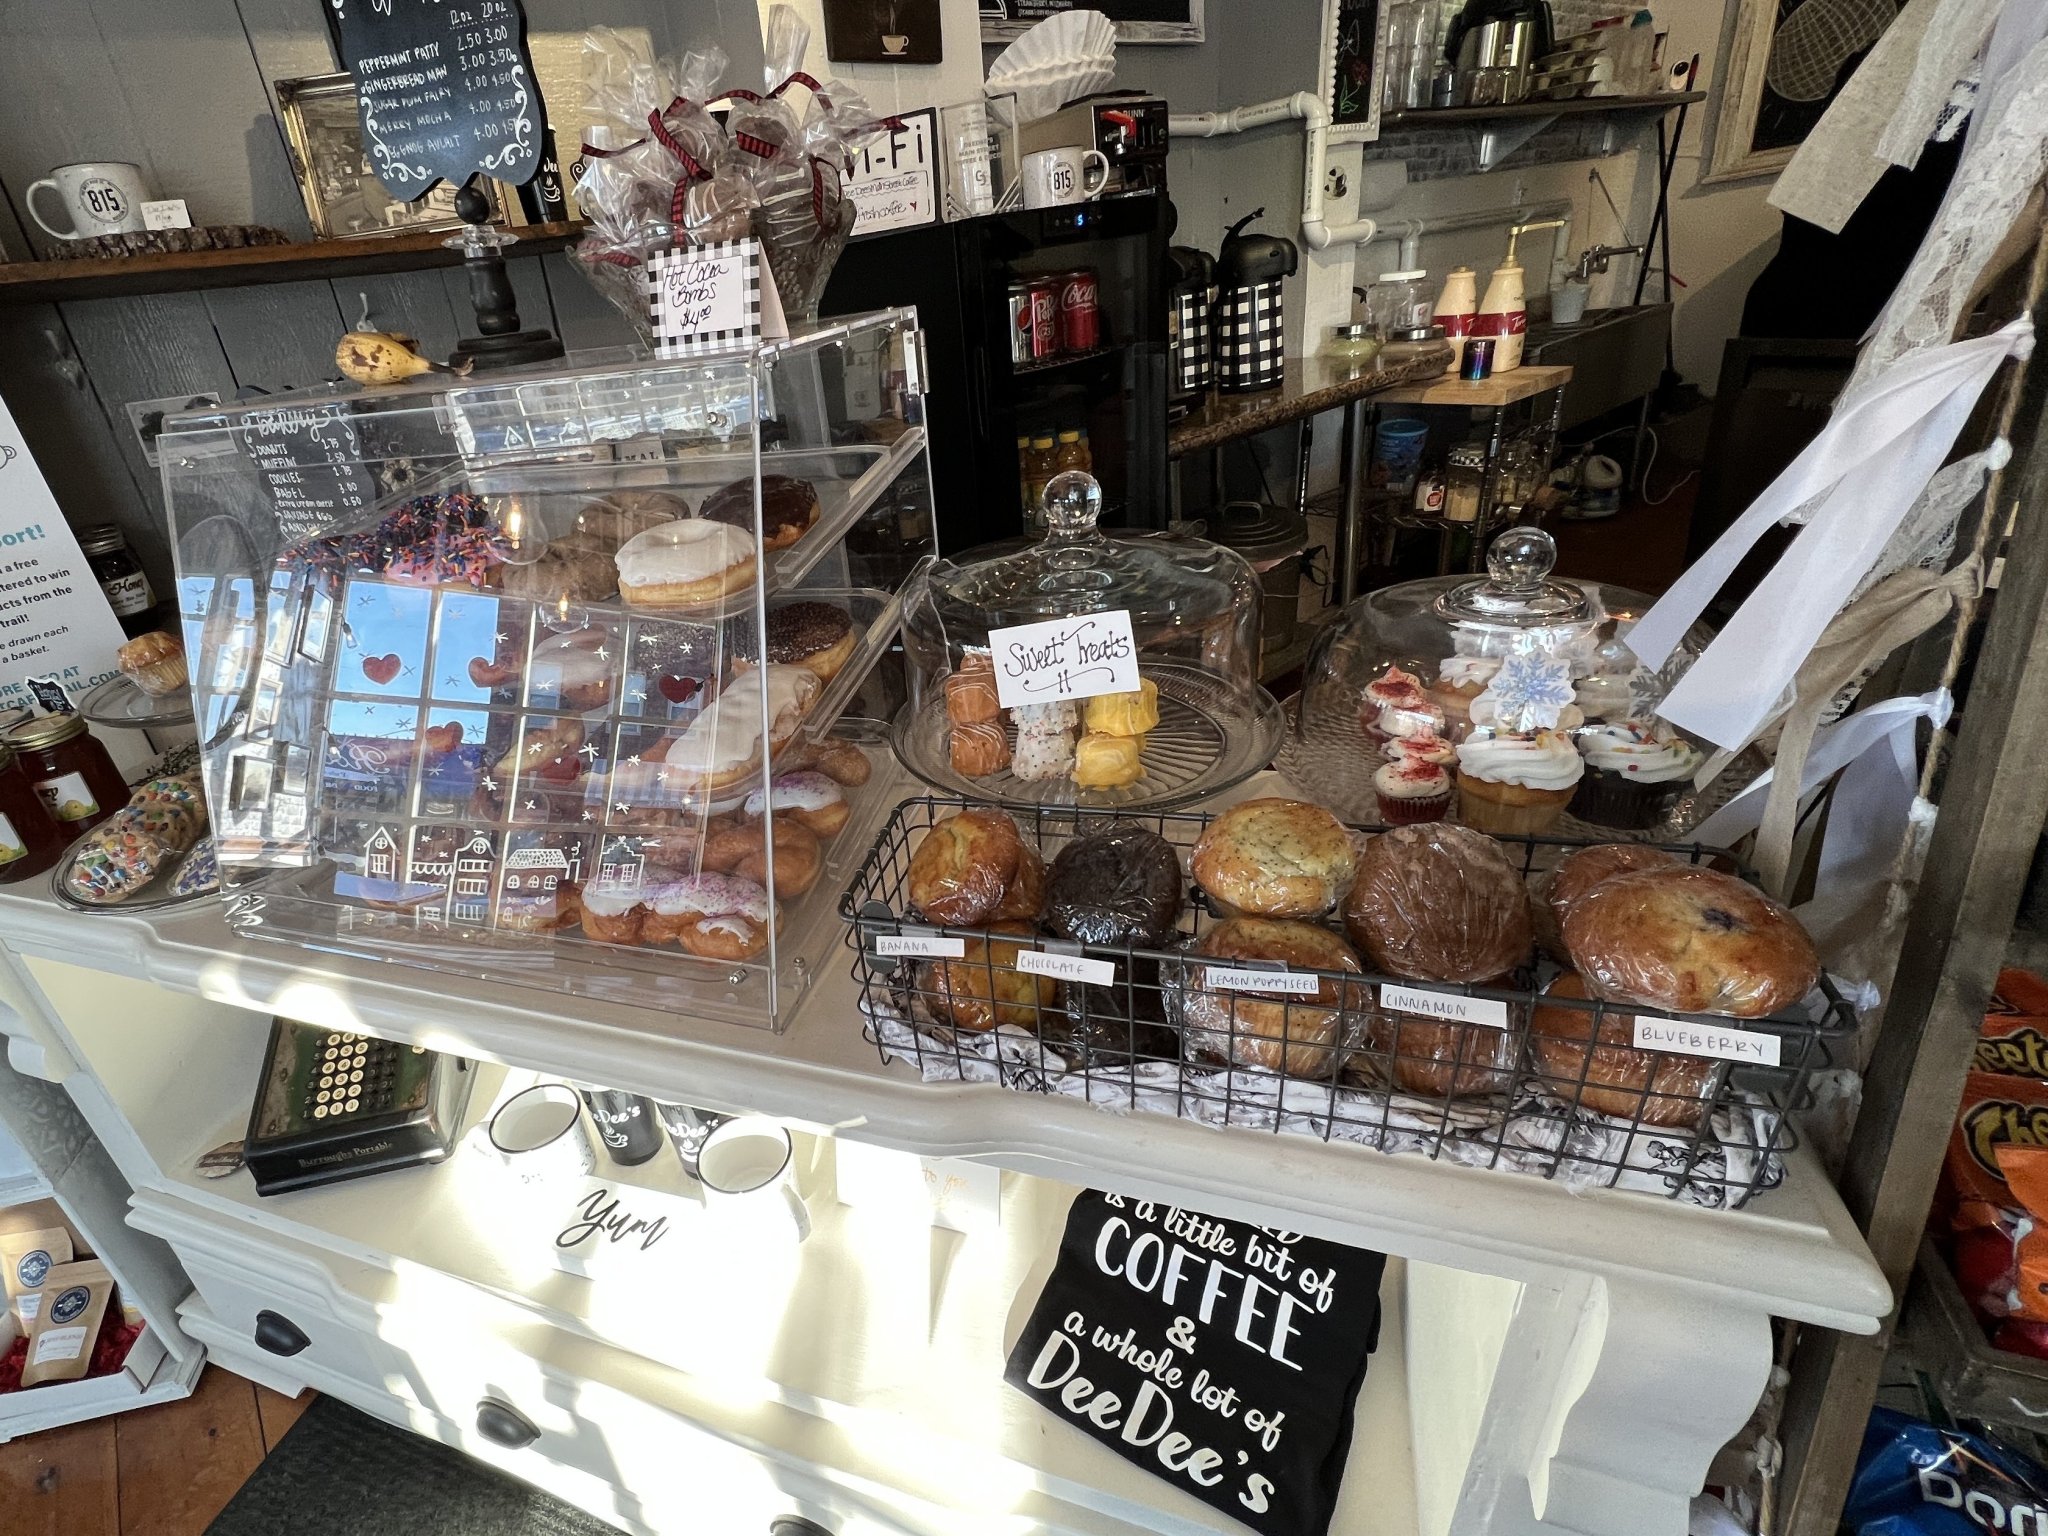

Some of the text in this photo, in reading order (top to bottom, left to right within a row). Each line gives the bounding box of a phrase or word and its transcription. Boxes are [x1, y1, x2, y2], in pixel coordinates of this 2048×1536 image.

[358, 25, 508, 75] PEPPERMINT PATTY 2.50 3.00
[364, 48, 512, 95] GINGERBREAD MAN 3.00 3.50
[379, 119, 412, 134] MERRY
[416, 111, 452, 126] MOCHA
[473, 123, 499, 141] 4.00
[1053, 169, 1071, 190] 815
[87, 188, 120, 213] 815
[663, 259, 730, 290] Hot Cocoa
[672, 282, 717, 308] Bombs
[256, 443, 288, 456] DONUTS
[260, 451, 346, 470] MUFFINS 2.50
[268, 471, 302, 485] COOKIES
[273, 482, 358, 499] BAGEL 3.00
[342, 495, 362, 507] 0.50
[0, 524, 46, 548] ort!
[13, 558, 39, 572] free
[0, 568, 71, 593] tered to win
[22, 591, 52, 605] from
[52, 586, 73, 598] the
[0, 613, 30, 628] trail!
[8, 633, 42, 648] drawn
[43, 625, 70, 638] each
[10, 645, 51, 662] basket.
[1004, 621, 1130, 677] Sweet Treats
[63, 666, 81, 679] AT
[878, 939, 931, 955] BANANA
[1018, 953, 1086, 976] CHOCOLATE
[1208, 972, 1251, 990] LEMON
[1384, 991, 1468, 1018] CINNAMON
[1640, 1024, 1766, 1059] BLUEBERRY
[297, 1140, 394, 1168] Burroughs Portable
[555, 1188, 670, 1251] Yum
[1134, 1200, 1158, 1223] a
[1163, 1205, 1237, 1257] little
[1244, 1234, 1296, 1282] bit
[1298, 1267, 1338, 1314] of
[1094, 1214, 1317, 1372] COFFEE
[1165, 1314, 1199, 1356] &
[1062, 1309, 1287, 1453] a whole lot of
[1025, 1328, 1277, 1515] DeeDee's
